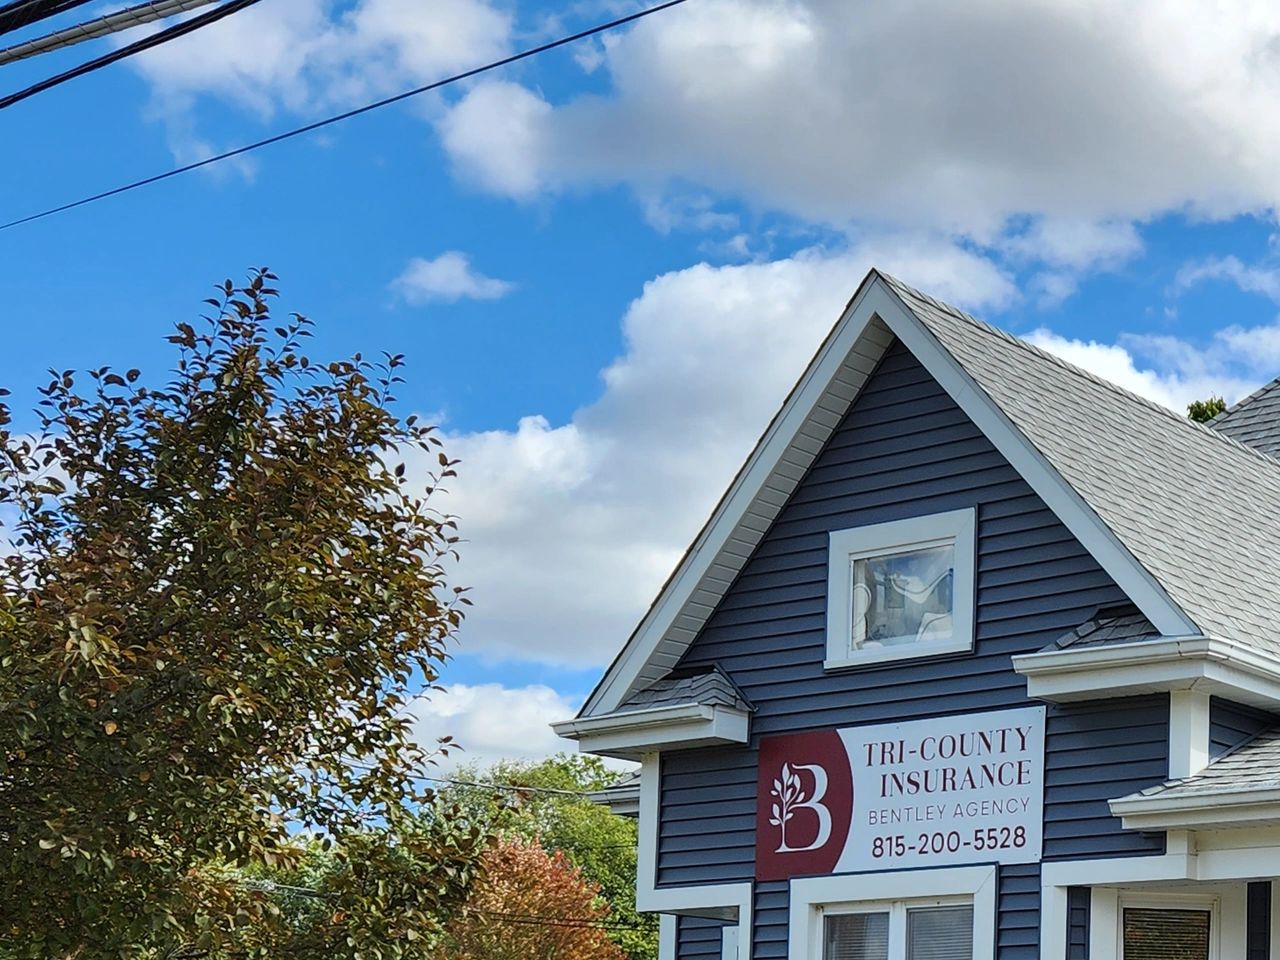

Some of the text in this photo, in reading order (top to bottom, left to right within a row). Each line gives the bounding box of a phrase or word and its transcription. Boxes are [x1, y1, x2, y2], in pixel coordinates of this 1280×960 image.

[863, 726, 1033, 767] TRI-COUNTY
[880, 760, 1032, 797] INSURANCE
[868, 797, 1030, 825] BENTLEY AGENCY
[872, 825, 1026, 858] 815-200-5528
